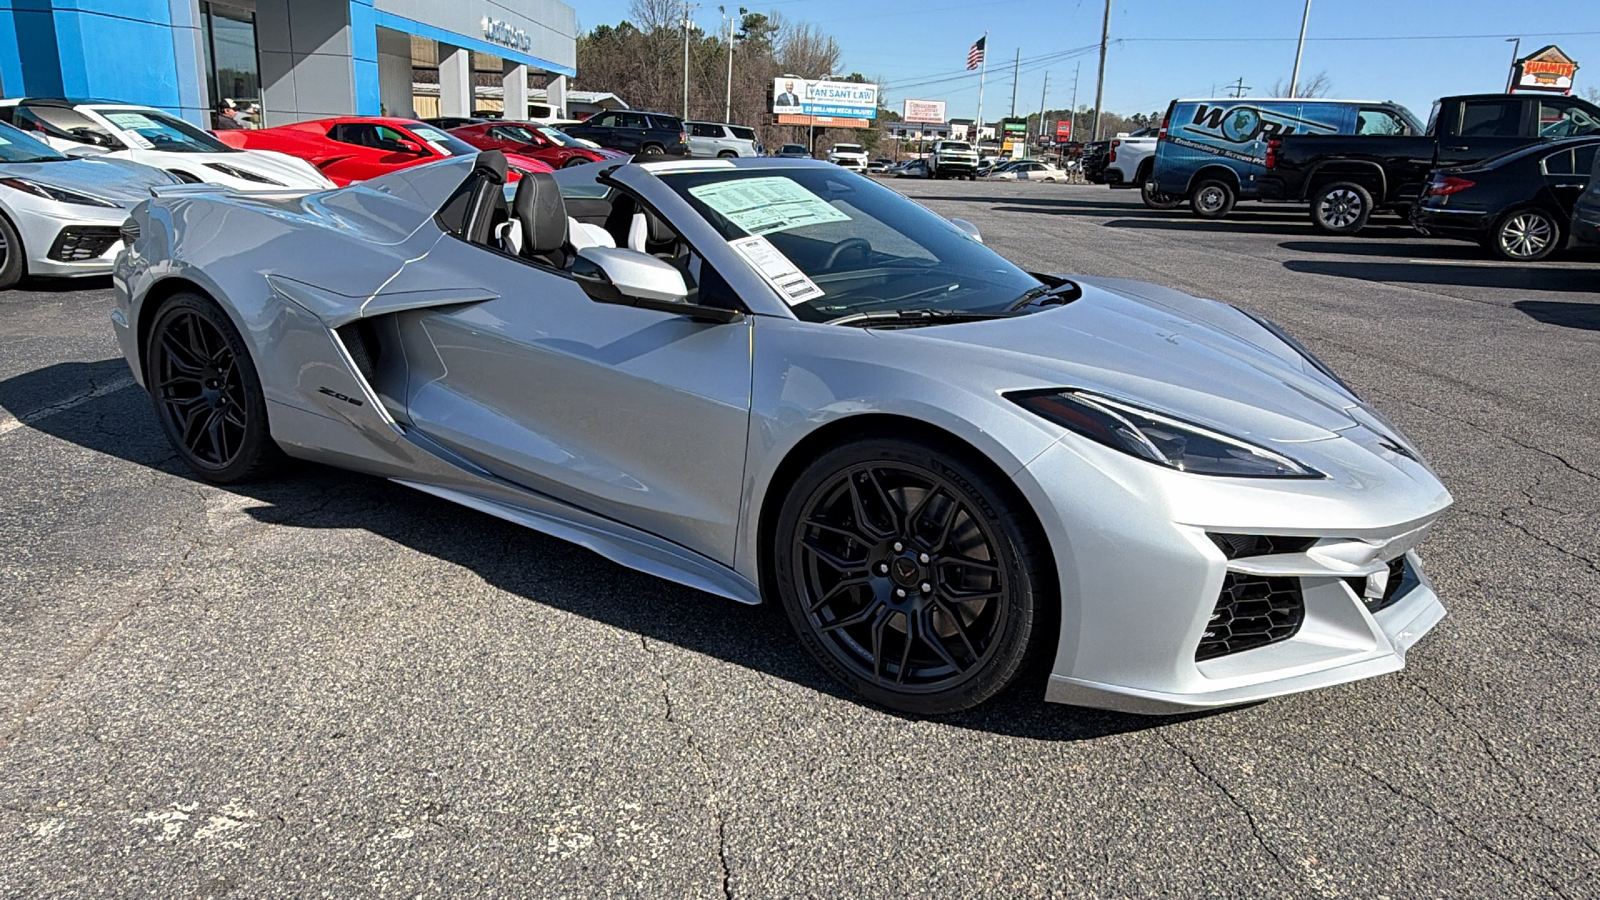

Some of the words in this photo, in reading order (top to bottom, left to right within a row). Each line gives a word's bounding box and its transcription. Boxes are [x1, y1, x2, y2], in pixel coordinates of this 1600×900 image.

[1525, 61, 1573, 76] SUMMITS
[810, 88, 827, 97] VAN
[829, 89, 851, 98] SANT
[853, 91, 871, 99] LAW
[1174, 137, 1220, 155] Embroidery
[1224, 150, 1252, 162] Screen
[1252, 157, 1266, 166] Pri
[944, 469, 996, 518] MICHELIN
